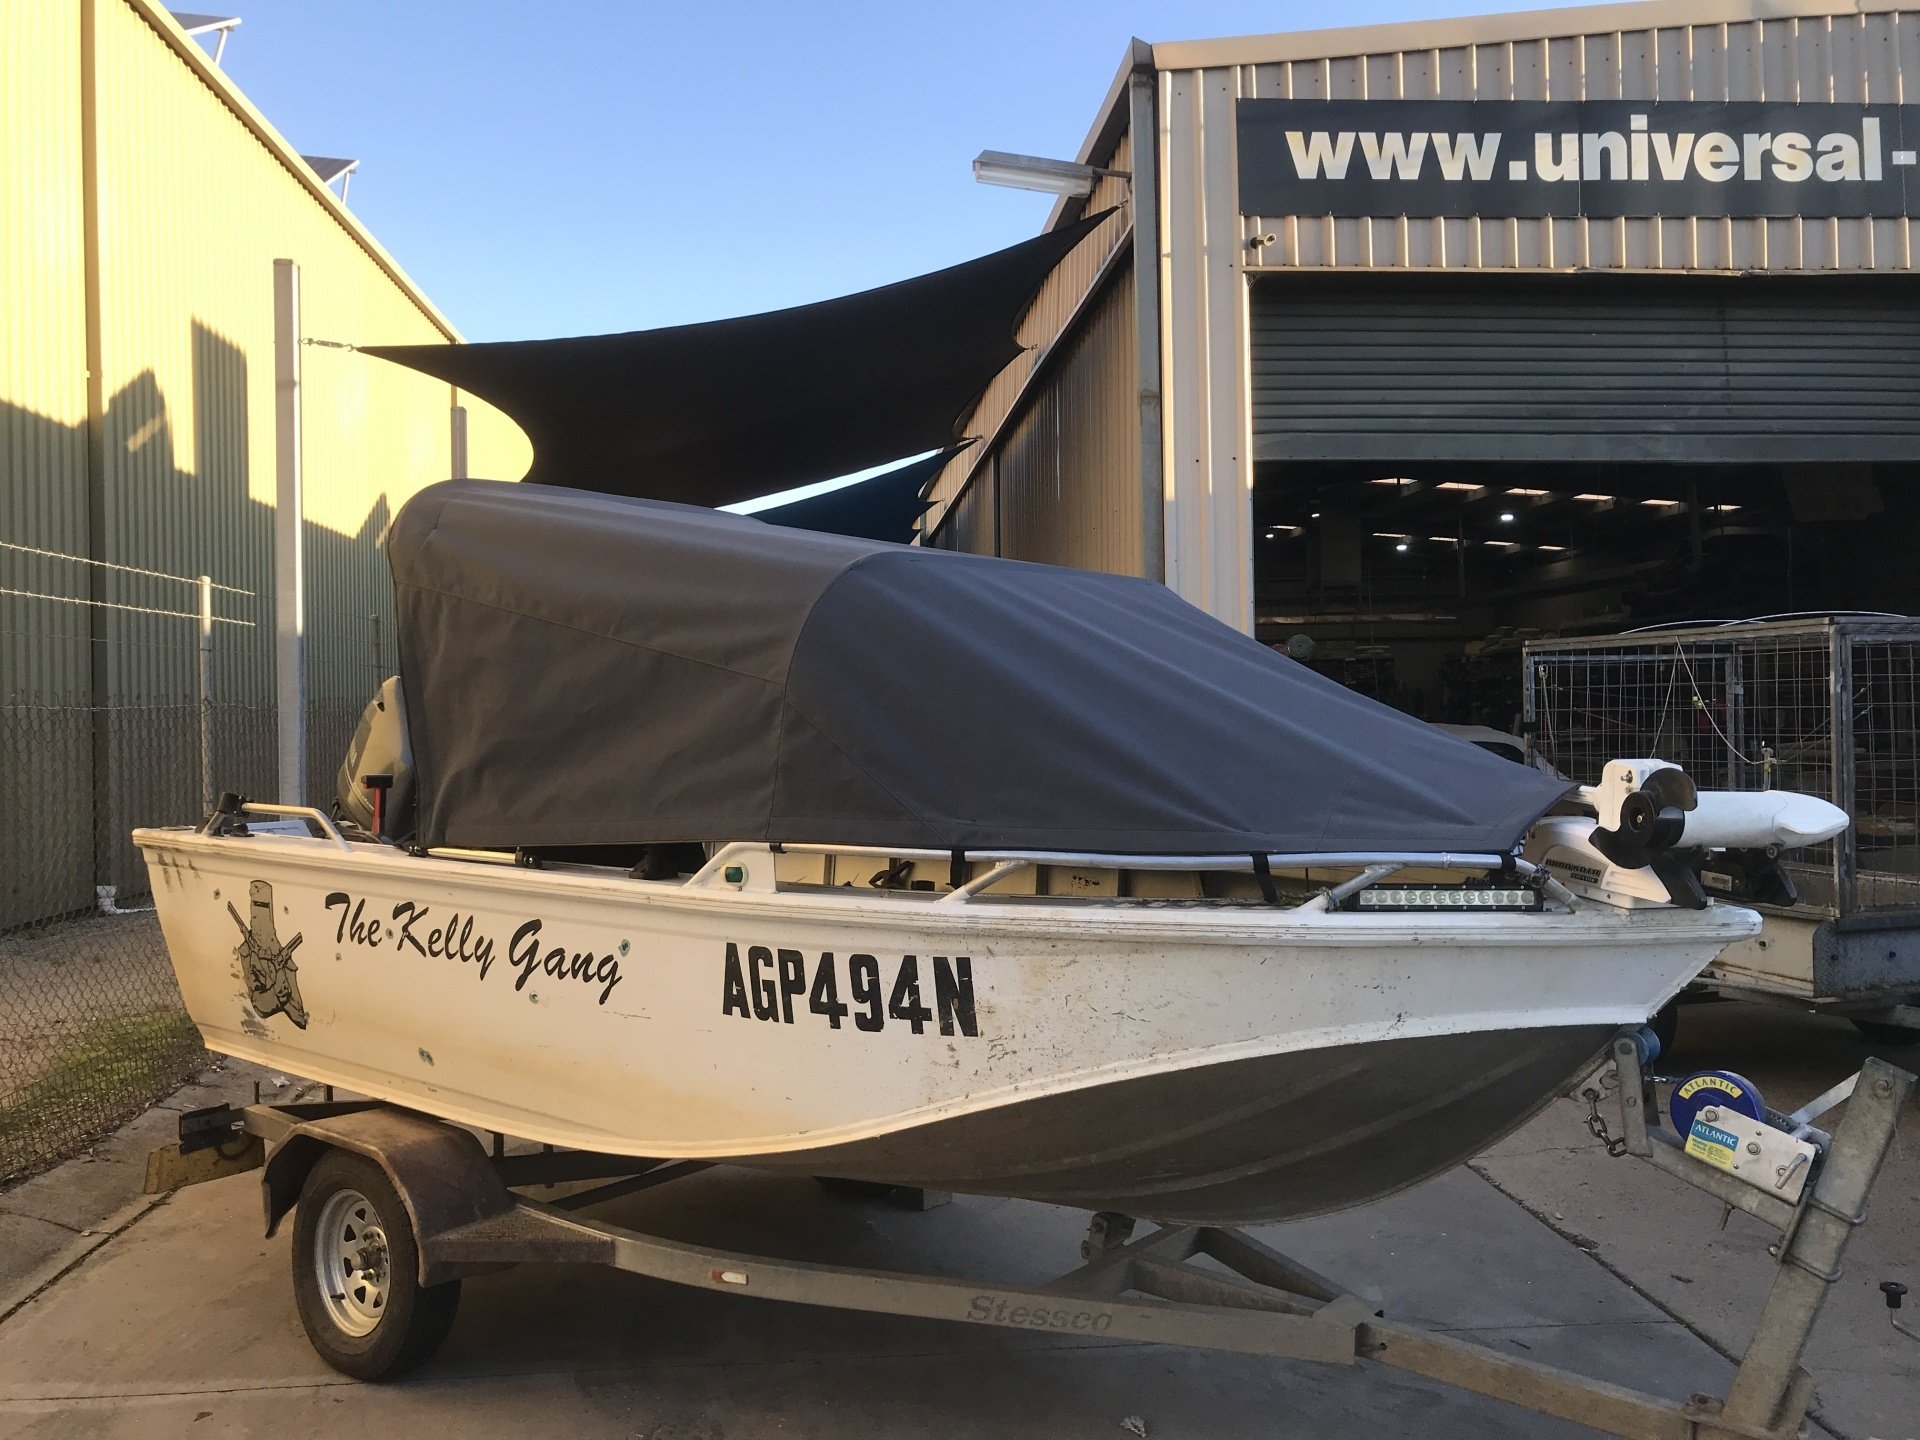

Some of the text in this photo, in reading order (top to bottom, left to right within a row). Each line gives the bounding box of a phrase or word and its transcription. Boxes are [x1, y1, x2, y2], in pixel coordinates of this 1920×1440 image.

[325, 892, 622, 1006] The Kelly Gang
[722, 942, 979, 1037] AGP494N
[1684, 1078, 1736, 1095] ATLANTIC
[1695, 1124, 1736, 1147] ATLANTIC
[967, 1295, 1113, 1331] Stessco
